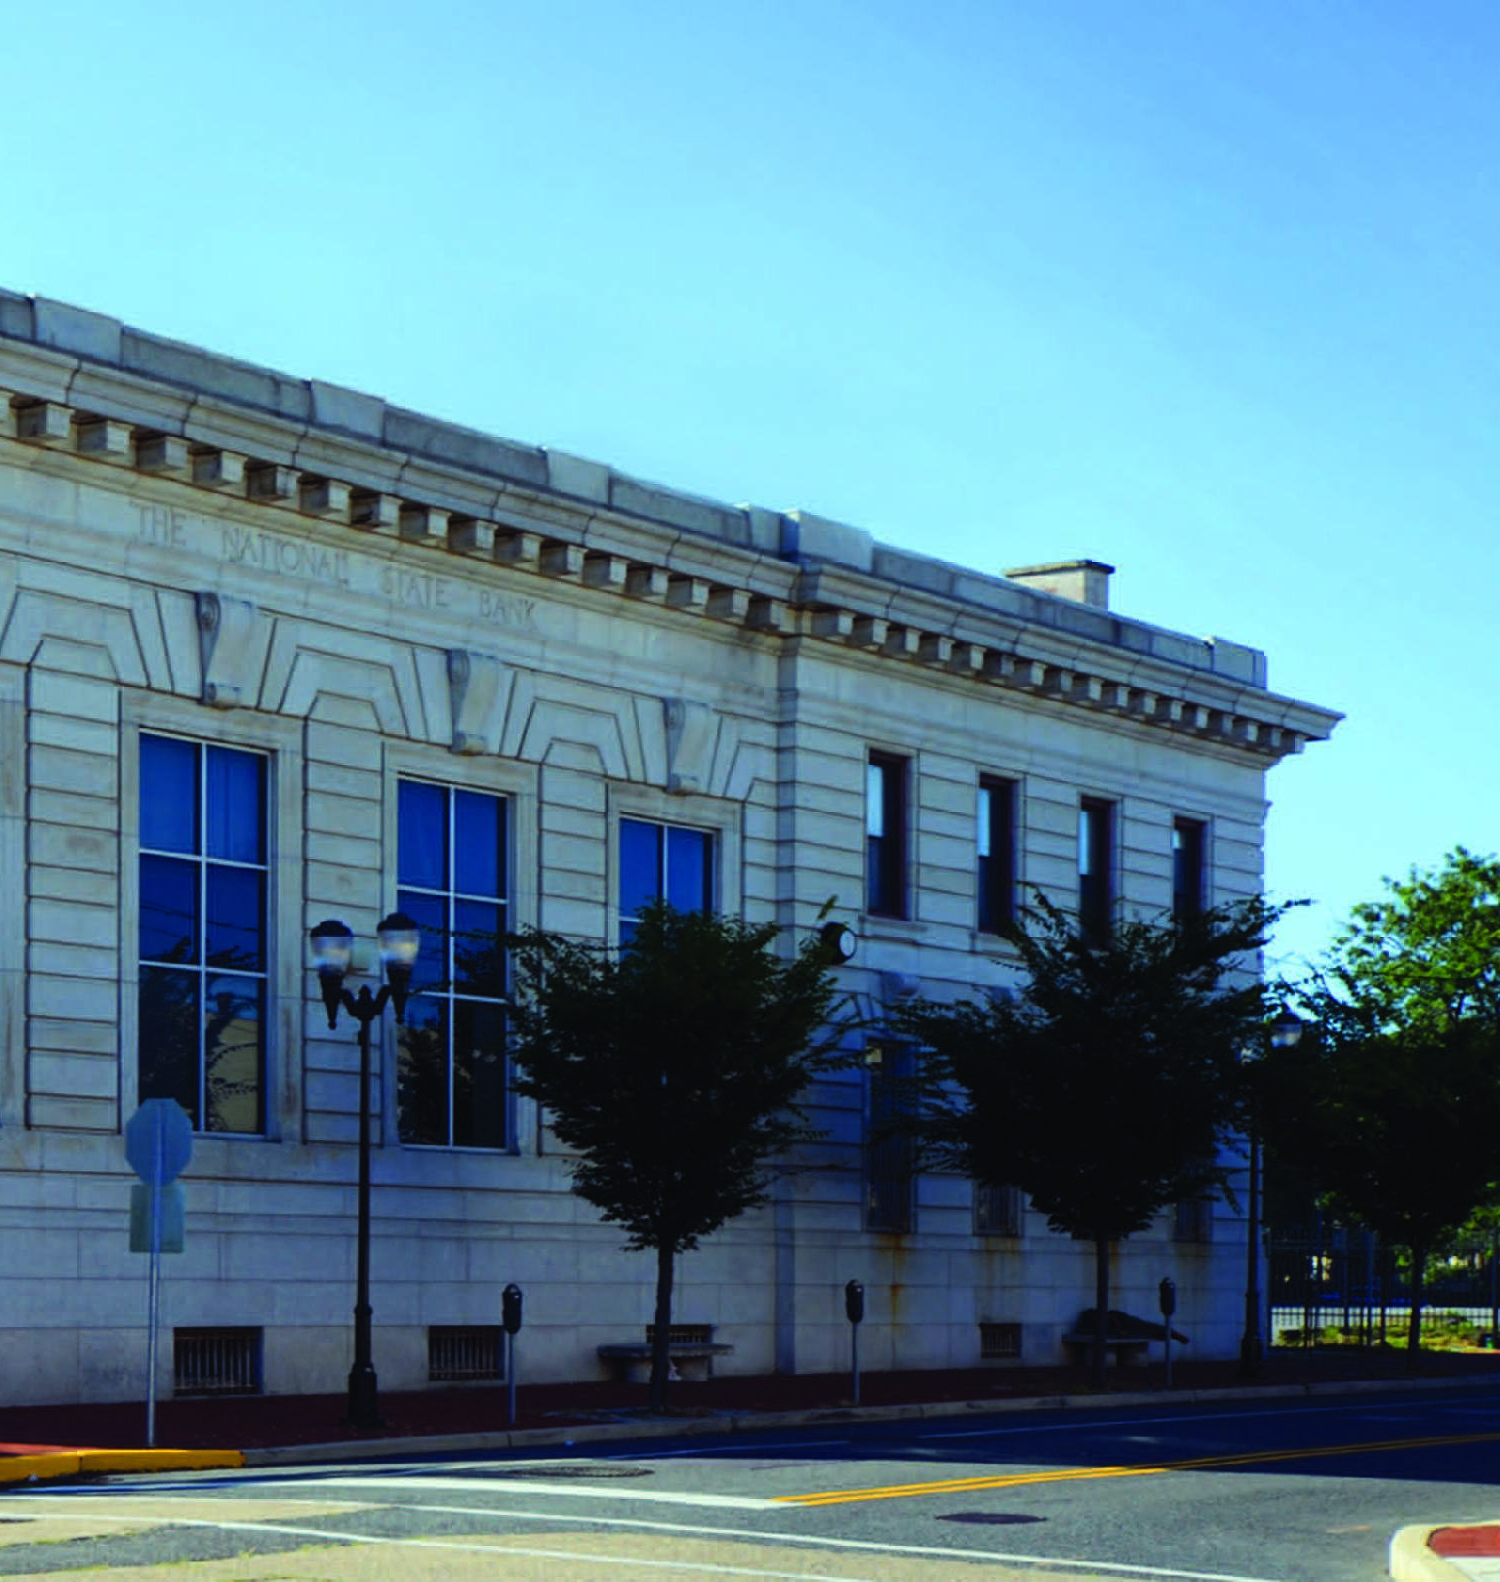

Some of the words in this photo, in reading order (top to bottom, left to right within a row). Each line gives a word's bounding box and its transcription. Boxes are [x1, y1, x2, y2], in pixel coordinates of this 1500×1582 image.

[139, 506, 187, 546] THE
[222, 526, 349, 579] NATIONAL
[381, 565, 454, 608] STATE
[478, 590, 536, 626] BANK
